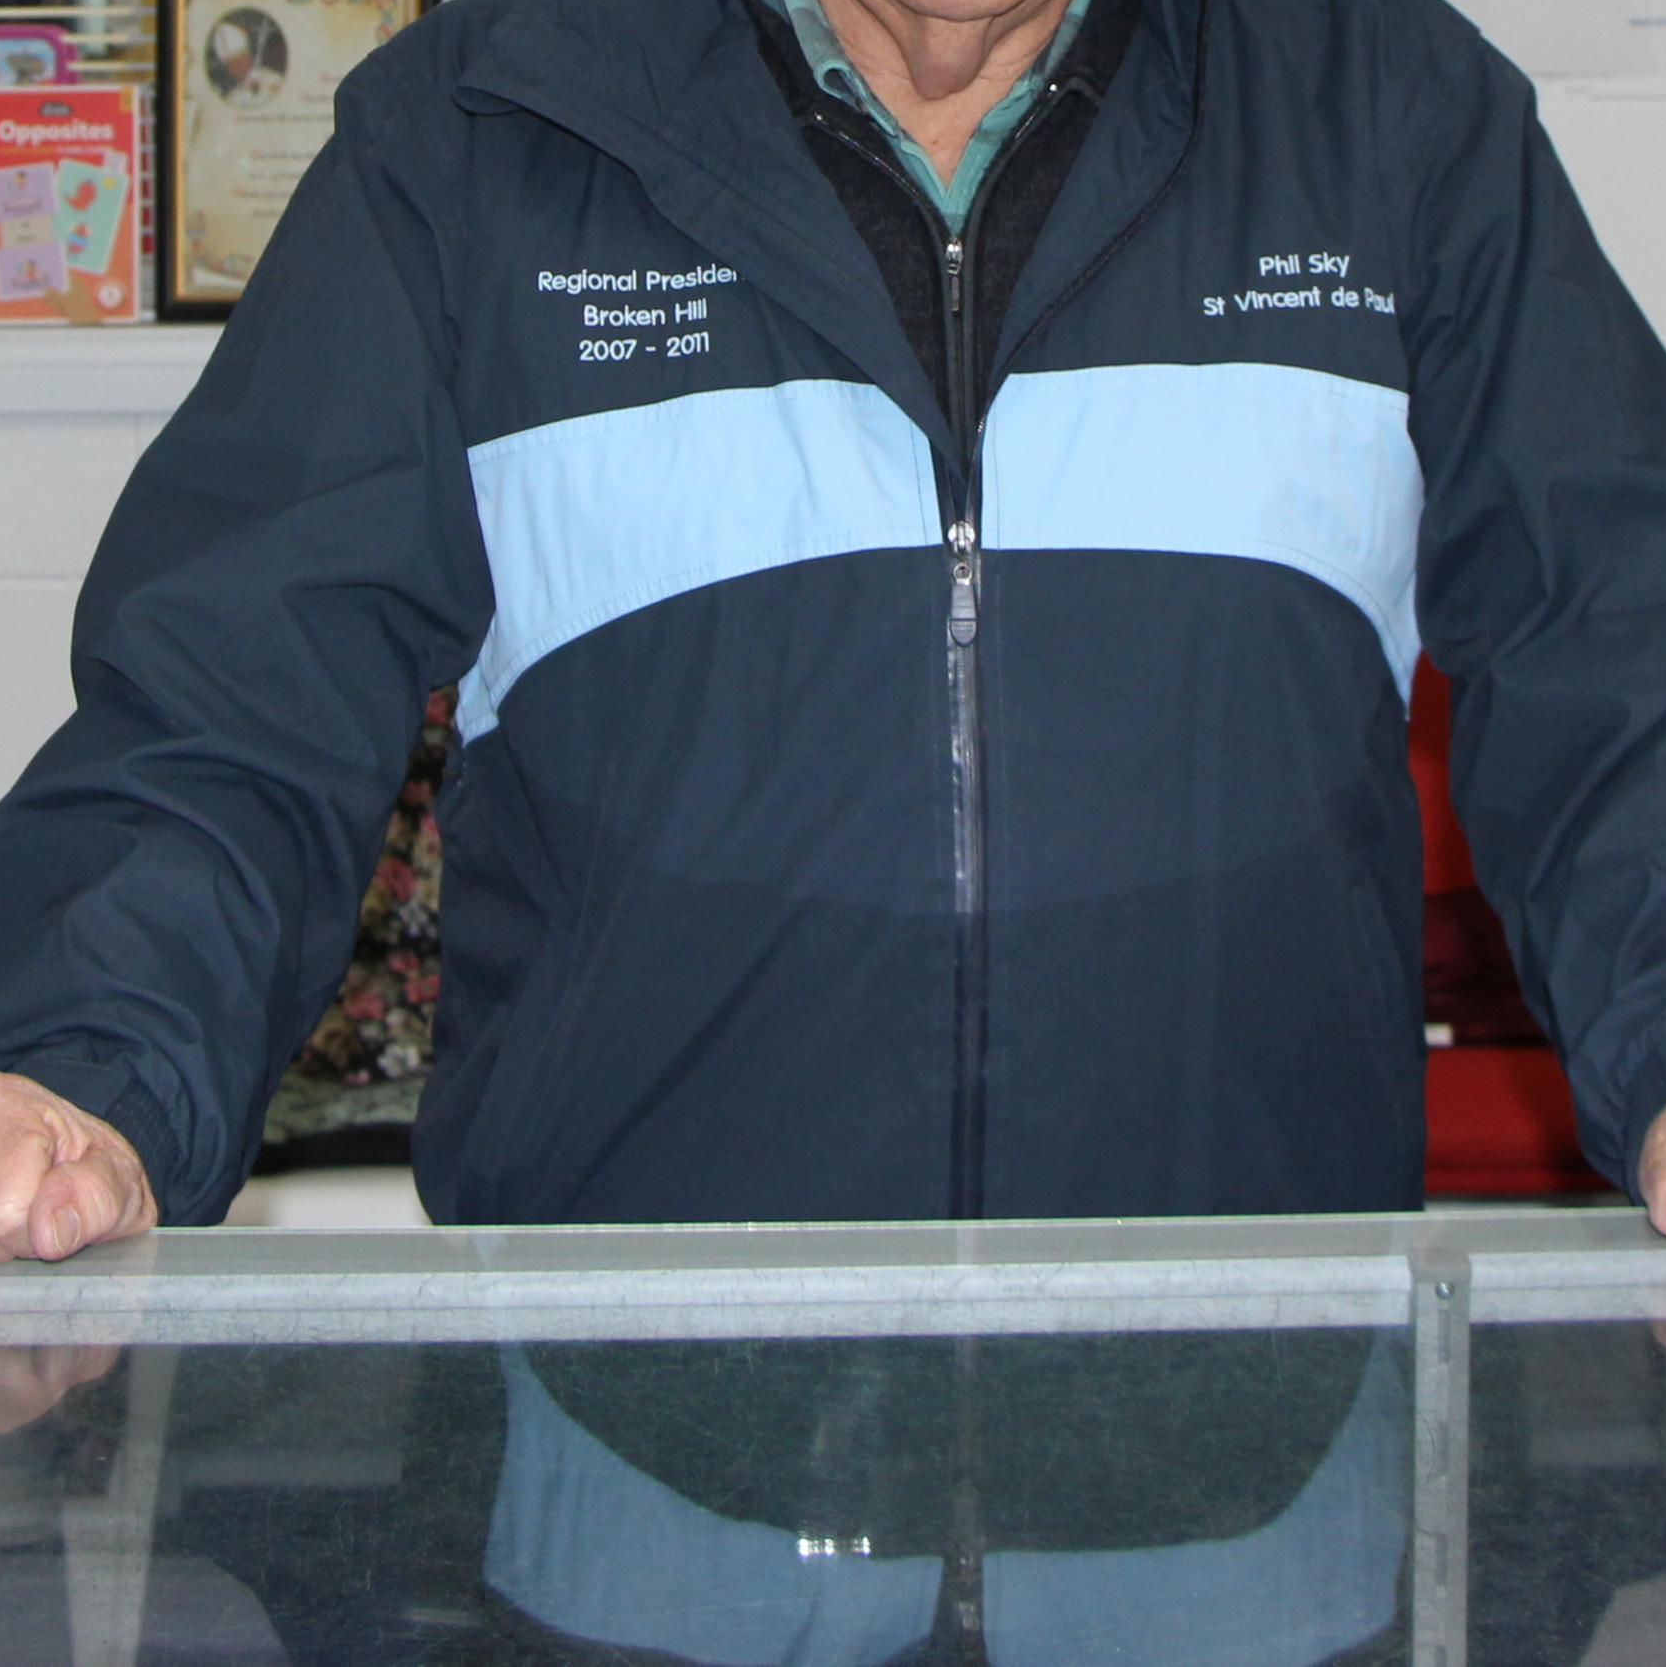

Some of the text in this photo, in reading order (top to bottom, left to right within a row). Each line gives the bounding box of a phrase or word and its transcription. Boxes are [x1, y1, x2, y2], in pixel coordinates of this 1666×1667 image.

[1259, 252, 1350, 278] Phil Sky
[538, 269, 637, 294] Regional
[584, 298, 707, 326] Broken Hill
[1203, 286, 1396, 316] St Vincent de Paul
[580, 339, 637, 361] 2007
[667, 331, 710, 357] 2011
